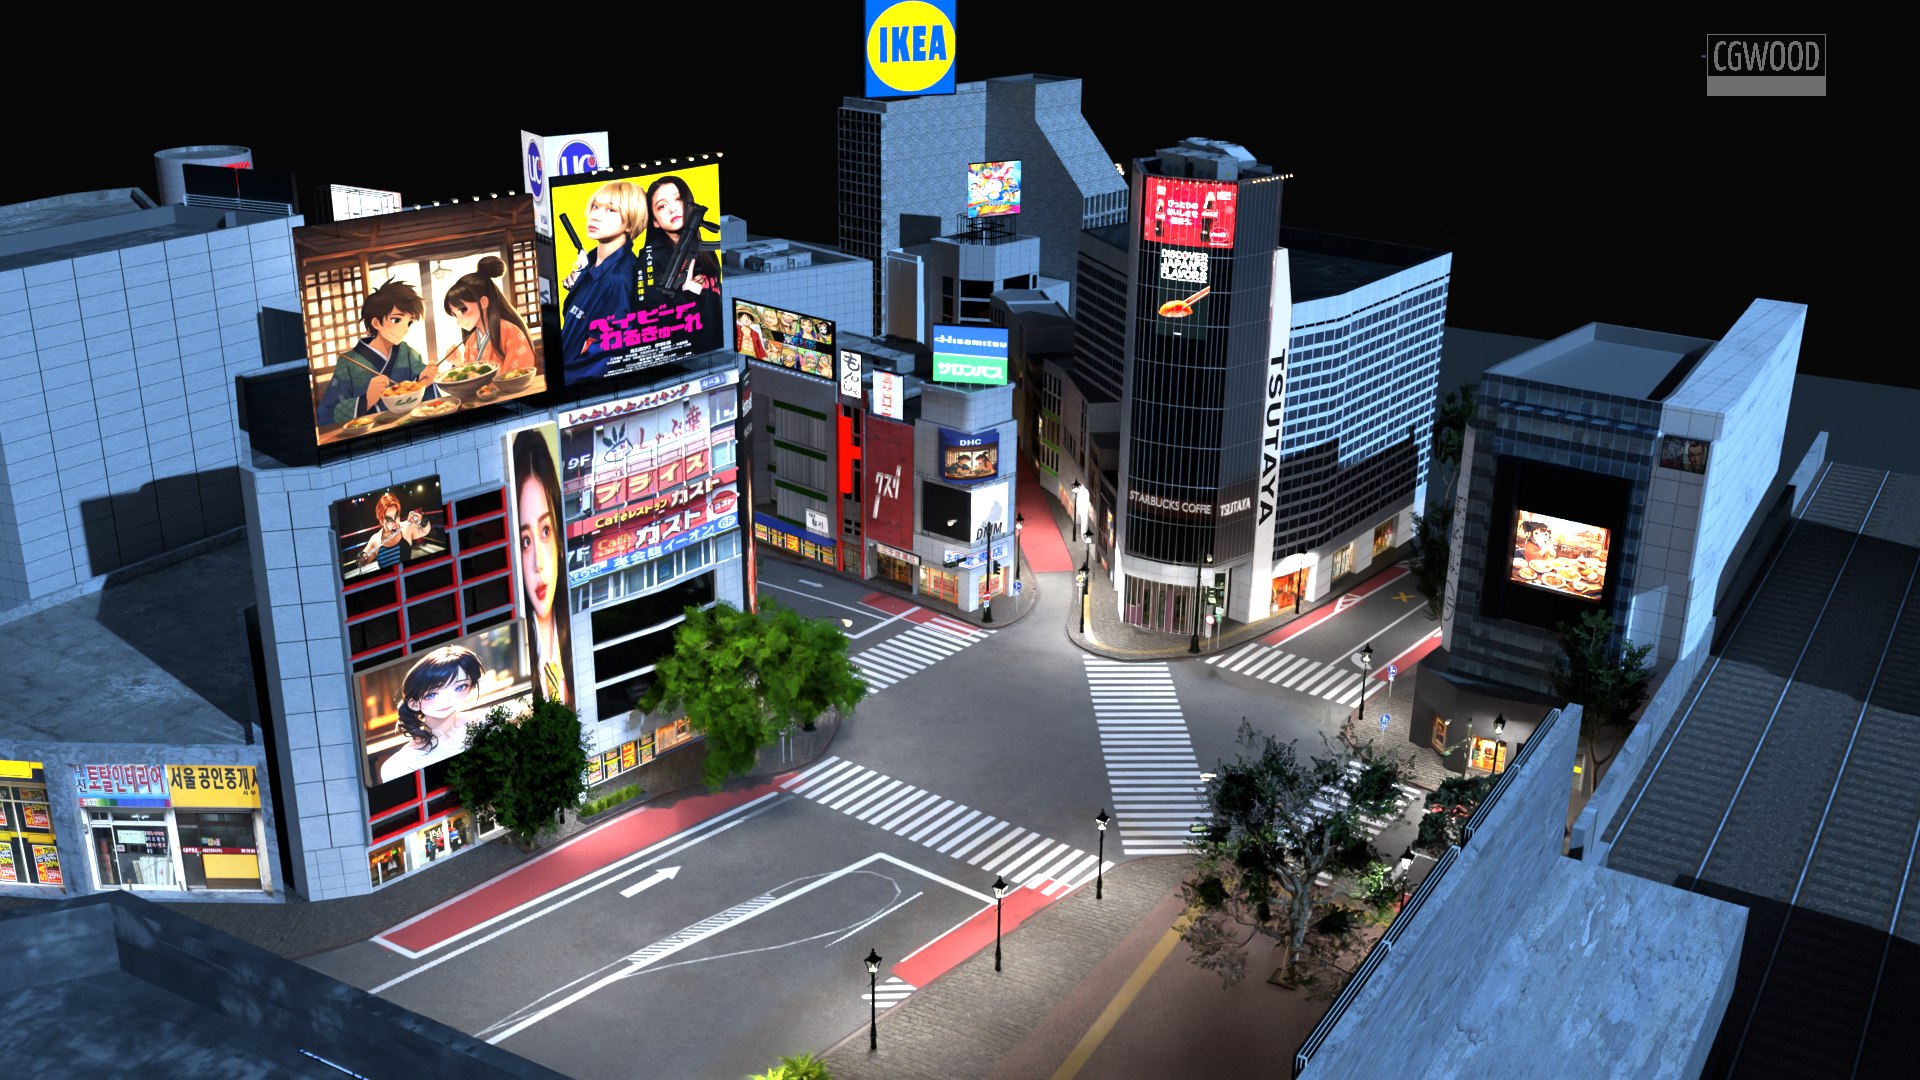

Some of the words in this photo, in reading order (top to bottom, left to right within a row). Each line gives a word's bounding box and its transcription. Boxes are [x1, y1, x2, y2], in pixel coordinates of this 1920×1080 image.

[879, 25, 947, 63] IKEA
[600, 313, 703, 351] わるきゅーれ
[934, 334, 1007, 348] Hisamitsu
[937, 361, 1003, 379] サロンパス
[568, 384, 690, 425] しゃぶしゃぶバイキング
[959, 438, 982, 447] DHC
[1259, 348, 1286, 526] TSUTAYA
[567, 454, 591, 470] 9F
[670, 477, 721, 507] ガスト
[1129, 490, 1180, 511] STARBUCKS
[1220, 497, 1251, 517] TSUTAYA
[634, 508, 701, 550] ガスト
[720, 516, 734, 528] 6F
[86, 763, 165, 795] 토탈인테리어
